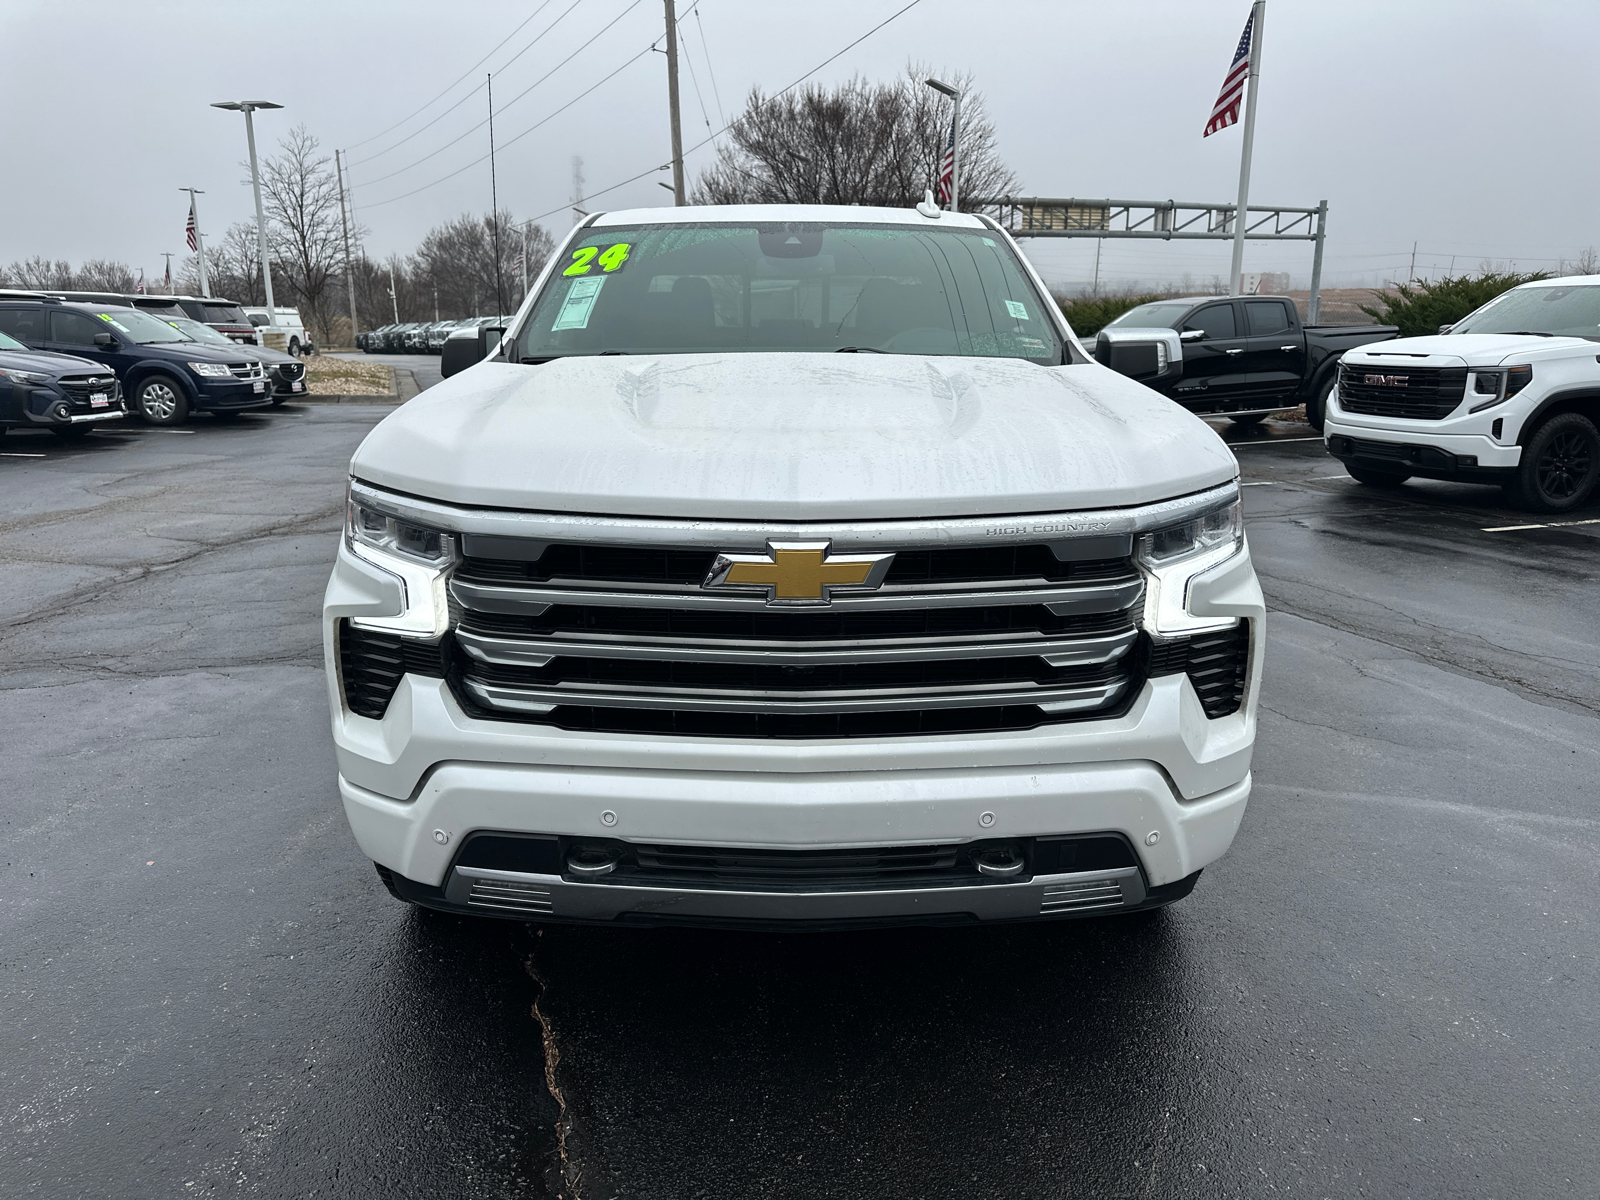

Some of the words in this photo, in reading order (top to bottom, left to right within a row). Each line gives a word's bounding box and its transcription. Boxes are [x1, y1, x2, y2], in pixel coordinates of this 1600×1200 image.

[562, 243, 632, 276] 24
[1364, 374, 1409, 387] GMC
[986, 526, 1027, 536] HIGH
[1033, 521, 1111, 534] COUNTRY
